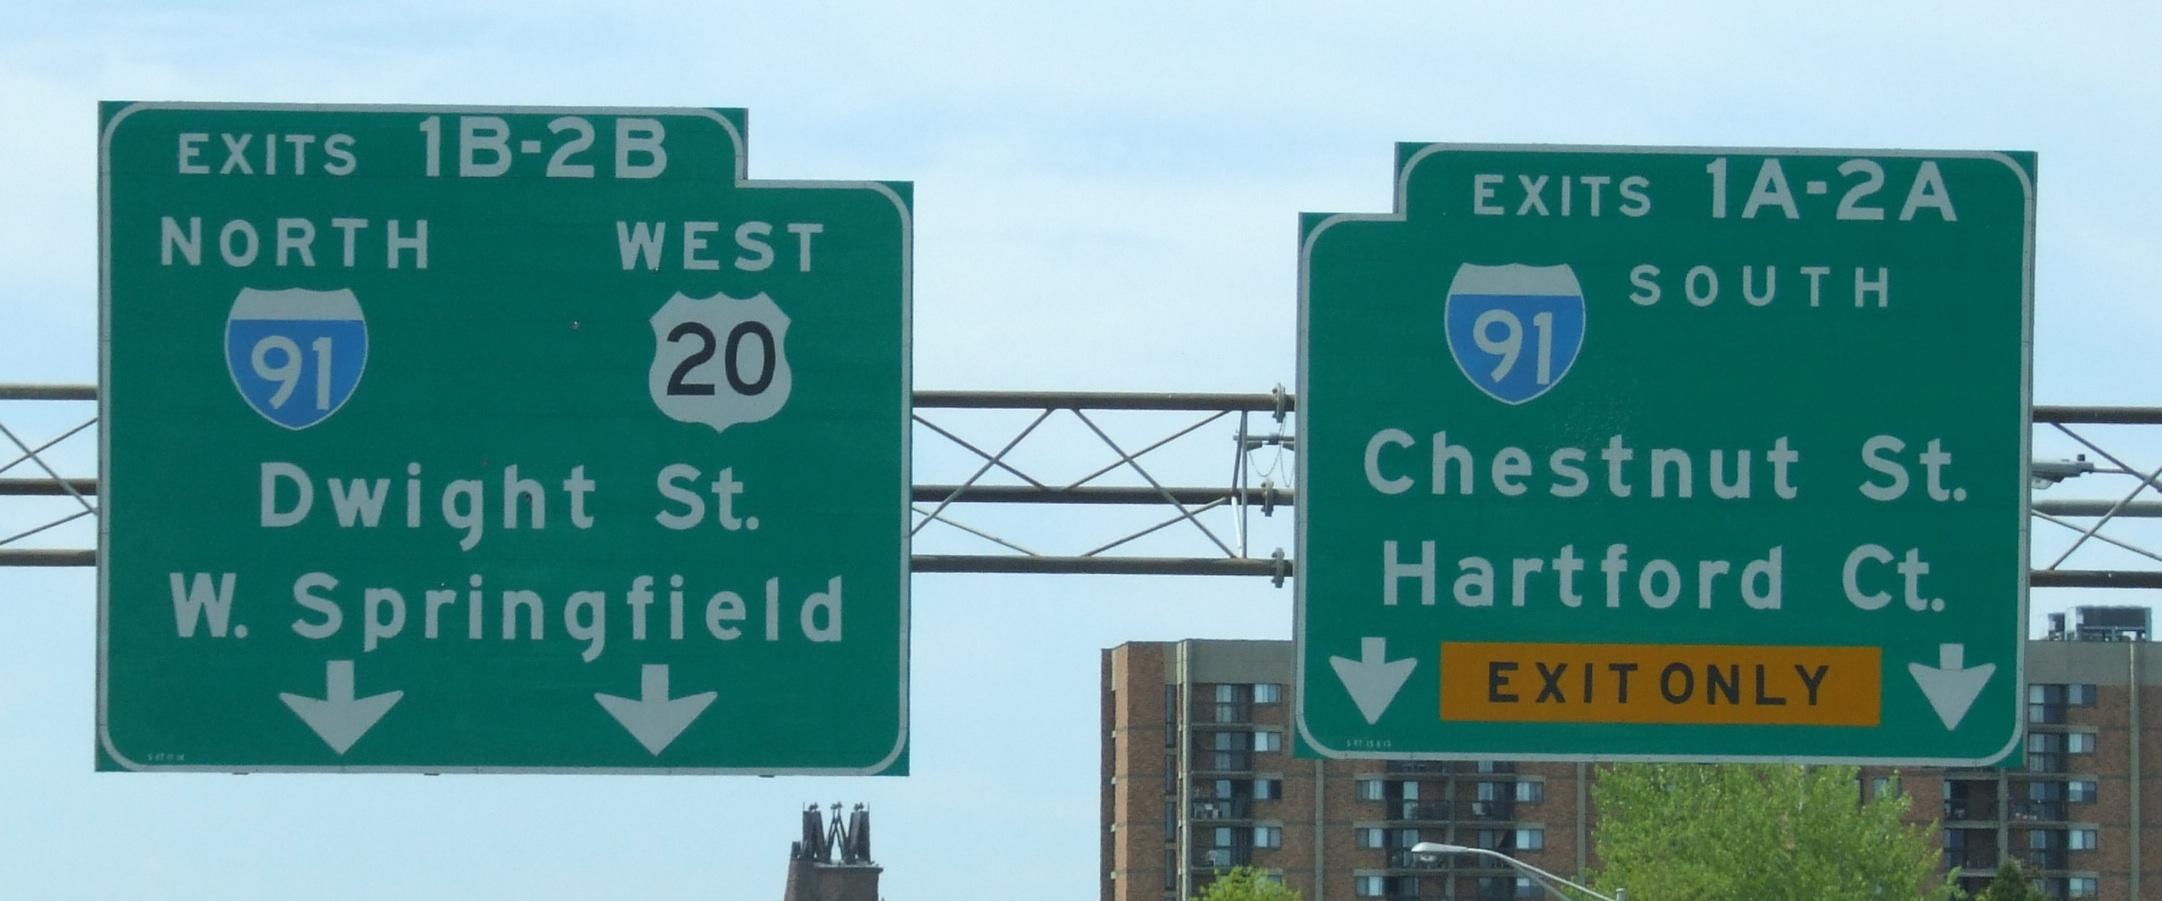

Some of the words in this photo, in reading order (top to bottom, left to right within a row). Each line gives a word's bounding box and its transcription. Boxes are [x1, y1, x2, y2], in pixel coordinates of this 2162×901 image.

[179, 133, 356, 176] EXITS
[420, 115, 667, 179] 1B-2B
[1475, 174, 1651, 217] EXITS
[1707, 157, 1957, 221] 1A-2A
[162, 217, 428, 269] NORTH
[617, 221, 823, 272] WEST
[1629, 264, 1889, 308] SOUTH
[251, 336, 332, 411] 91
[667, 321, 776, 396] 20
[1472, 309, 1553, 385] 91
[1364, 428, 1799, 500] Chestnut
[1859, 435, 1967, 502] St.
[261, 462, 595, 551] Dwight
[656, 463, 760, 531] St.
[1384, 540, 1782, 611] Hartford
[1842, 544, 1945, 612] Ct.
[170, 572, 248, 639] W.
[292, 572, 843, 663] Springfield
[1488, 661, 1638, 704] EXIT
[1660, 661, 1829, 706] ONLY
